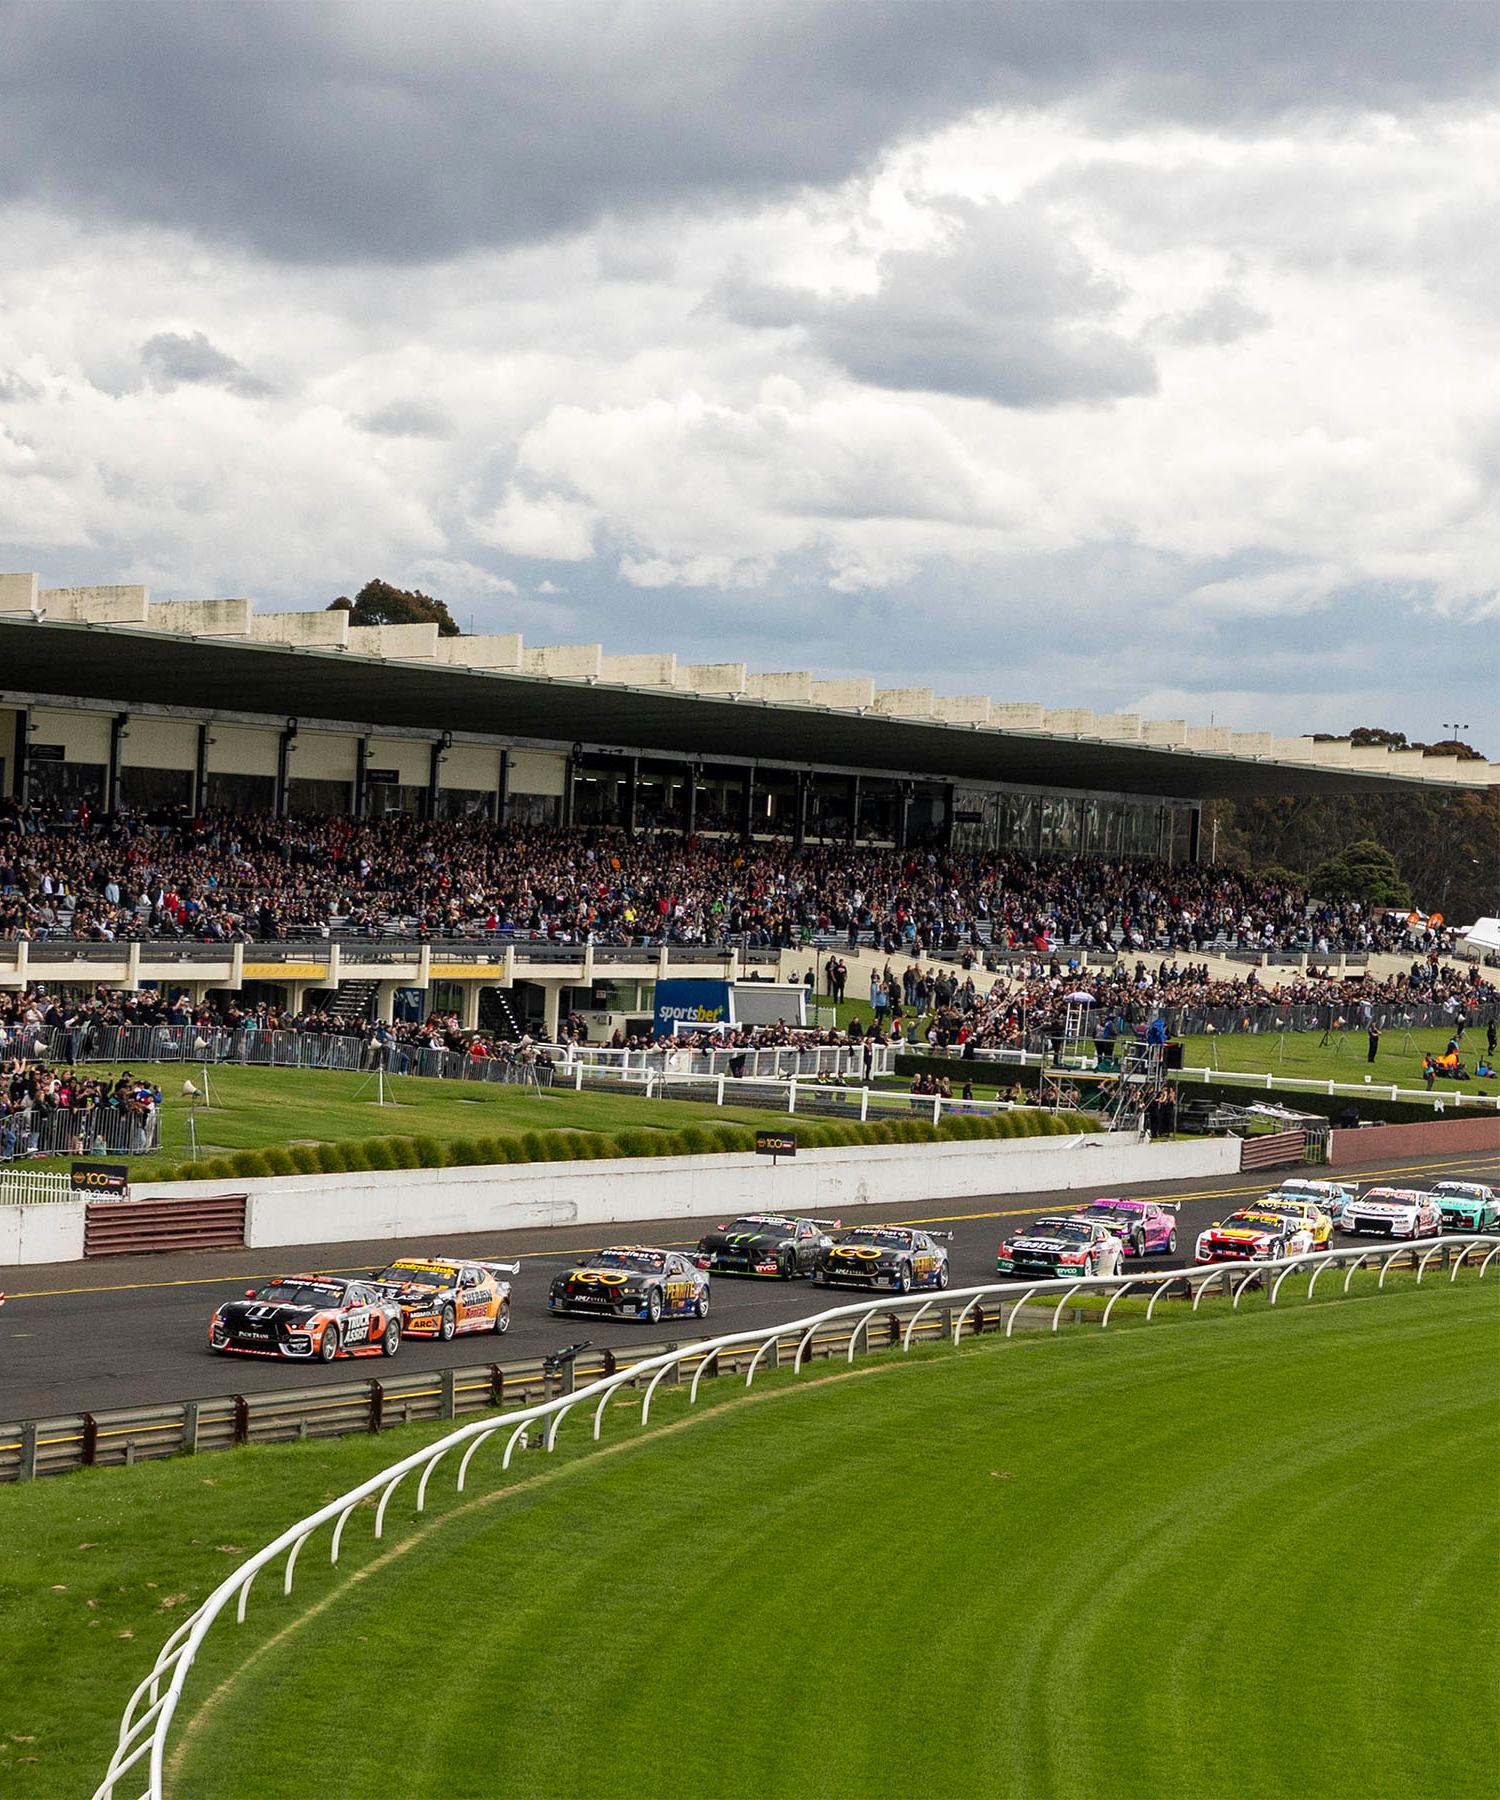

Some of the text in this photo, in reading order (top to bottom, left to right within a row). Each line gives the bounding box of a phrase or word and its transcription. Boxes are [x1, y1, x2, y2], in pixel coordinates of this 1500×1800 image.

[660, 1005, 719, 1022] sportsbet
[86, 1172, 108, 1185] 100
[1013, 1241, 1065, 1251] Castrol
[601, 1250, 650, 1258] Steadfast
[570, 1271, 628, 1285] 100
[462, 1289, 493, 1307] SHERRIN
[347, 1313, 370, 1330] TRUCK
[344, 1326, 370, 1344] ASSIST
